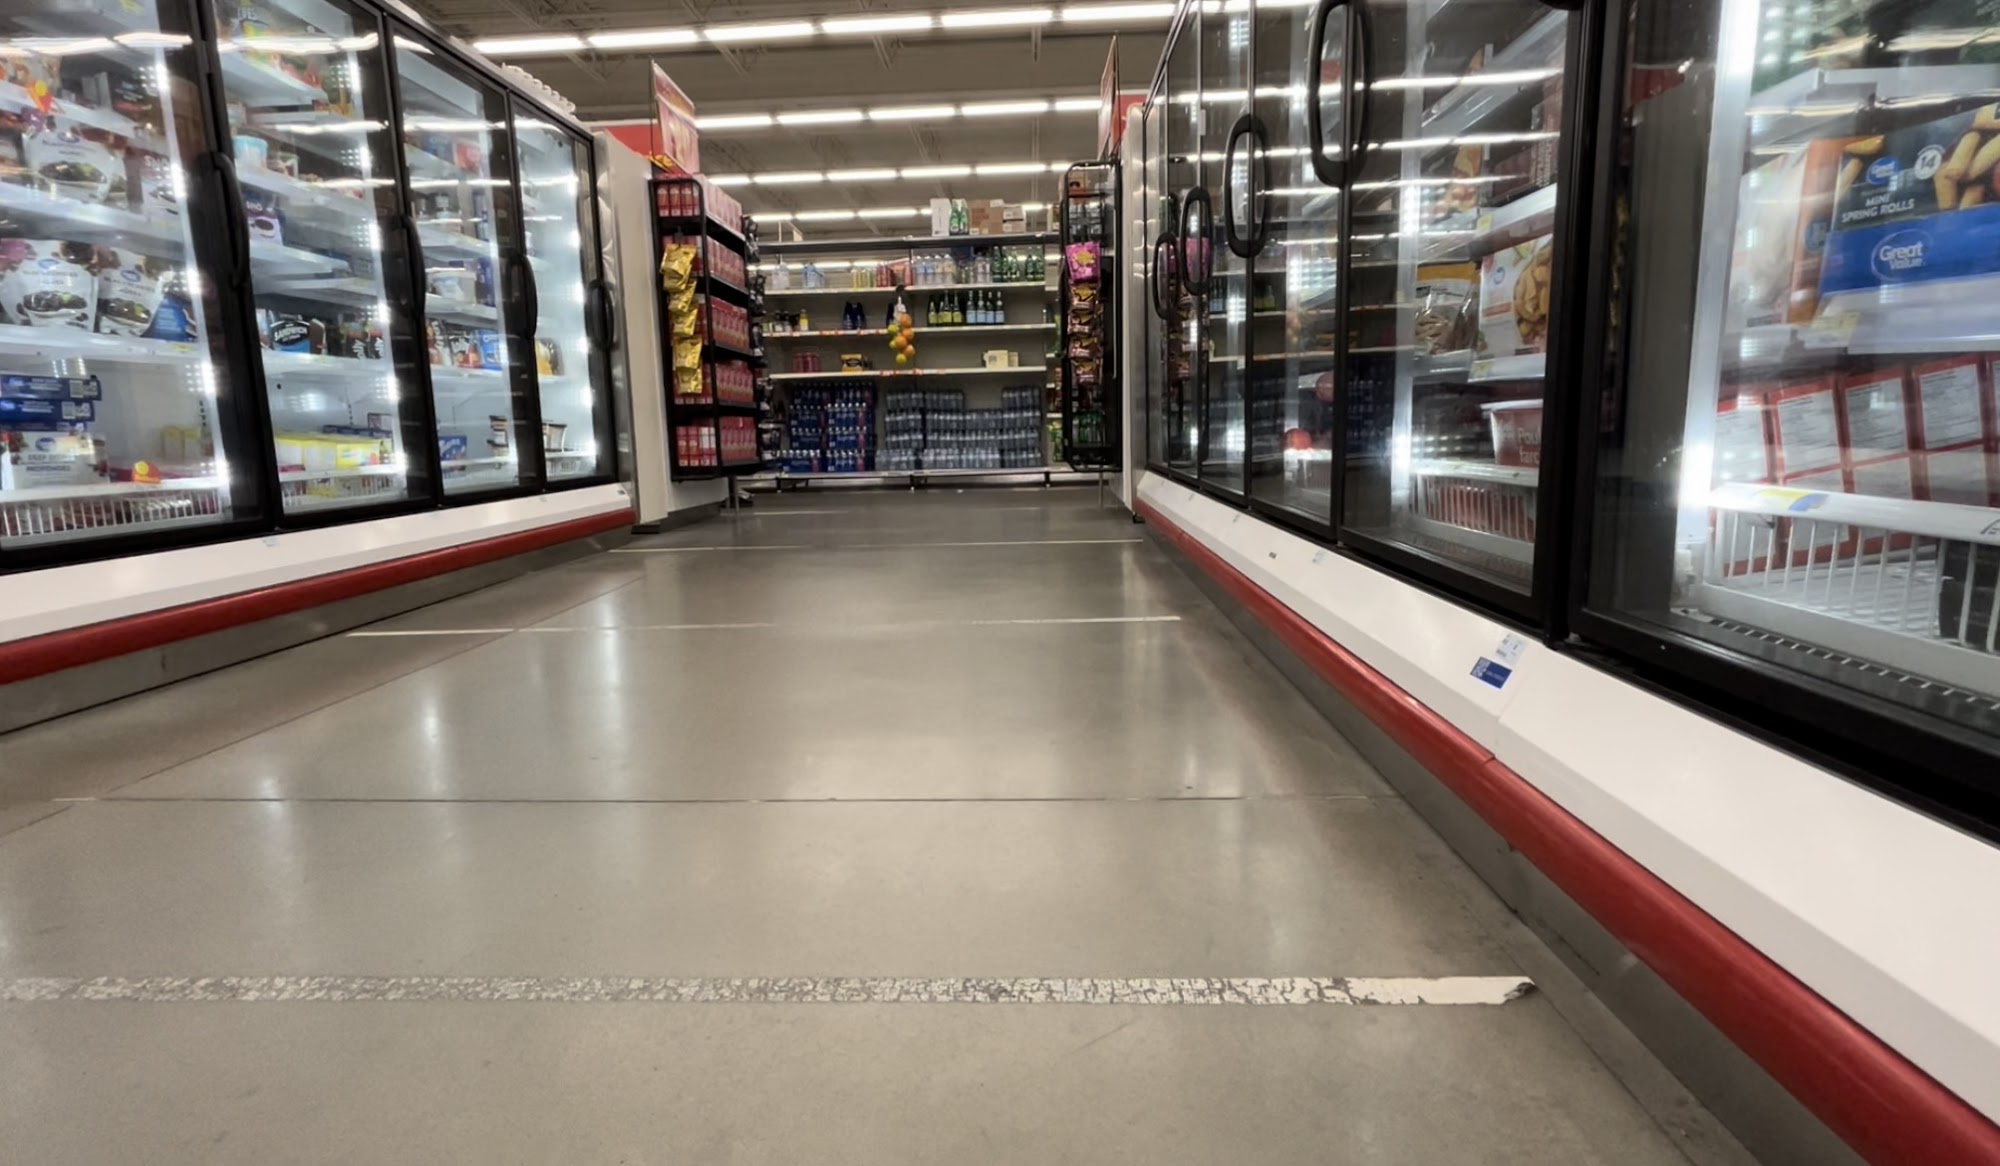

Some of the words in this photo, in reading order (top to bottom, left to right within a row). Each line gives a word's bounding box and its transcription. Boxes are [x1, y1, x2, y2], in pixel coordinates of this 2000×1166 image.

[1921, 154, 1936, 169] 14
[1865, 193, 1891, 207] MINI
[1842, 207, 1878, 222] SPRING
[1880, 199, 1915, 214] ROLLS
[1880, 241, 1923, 261] Great
[1889, 258, 1924, 270] Value
